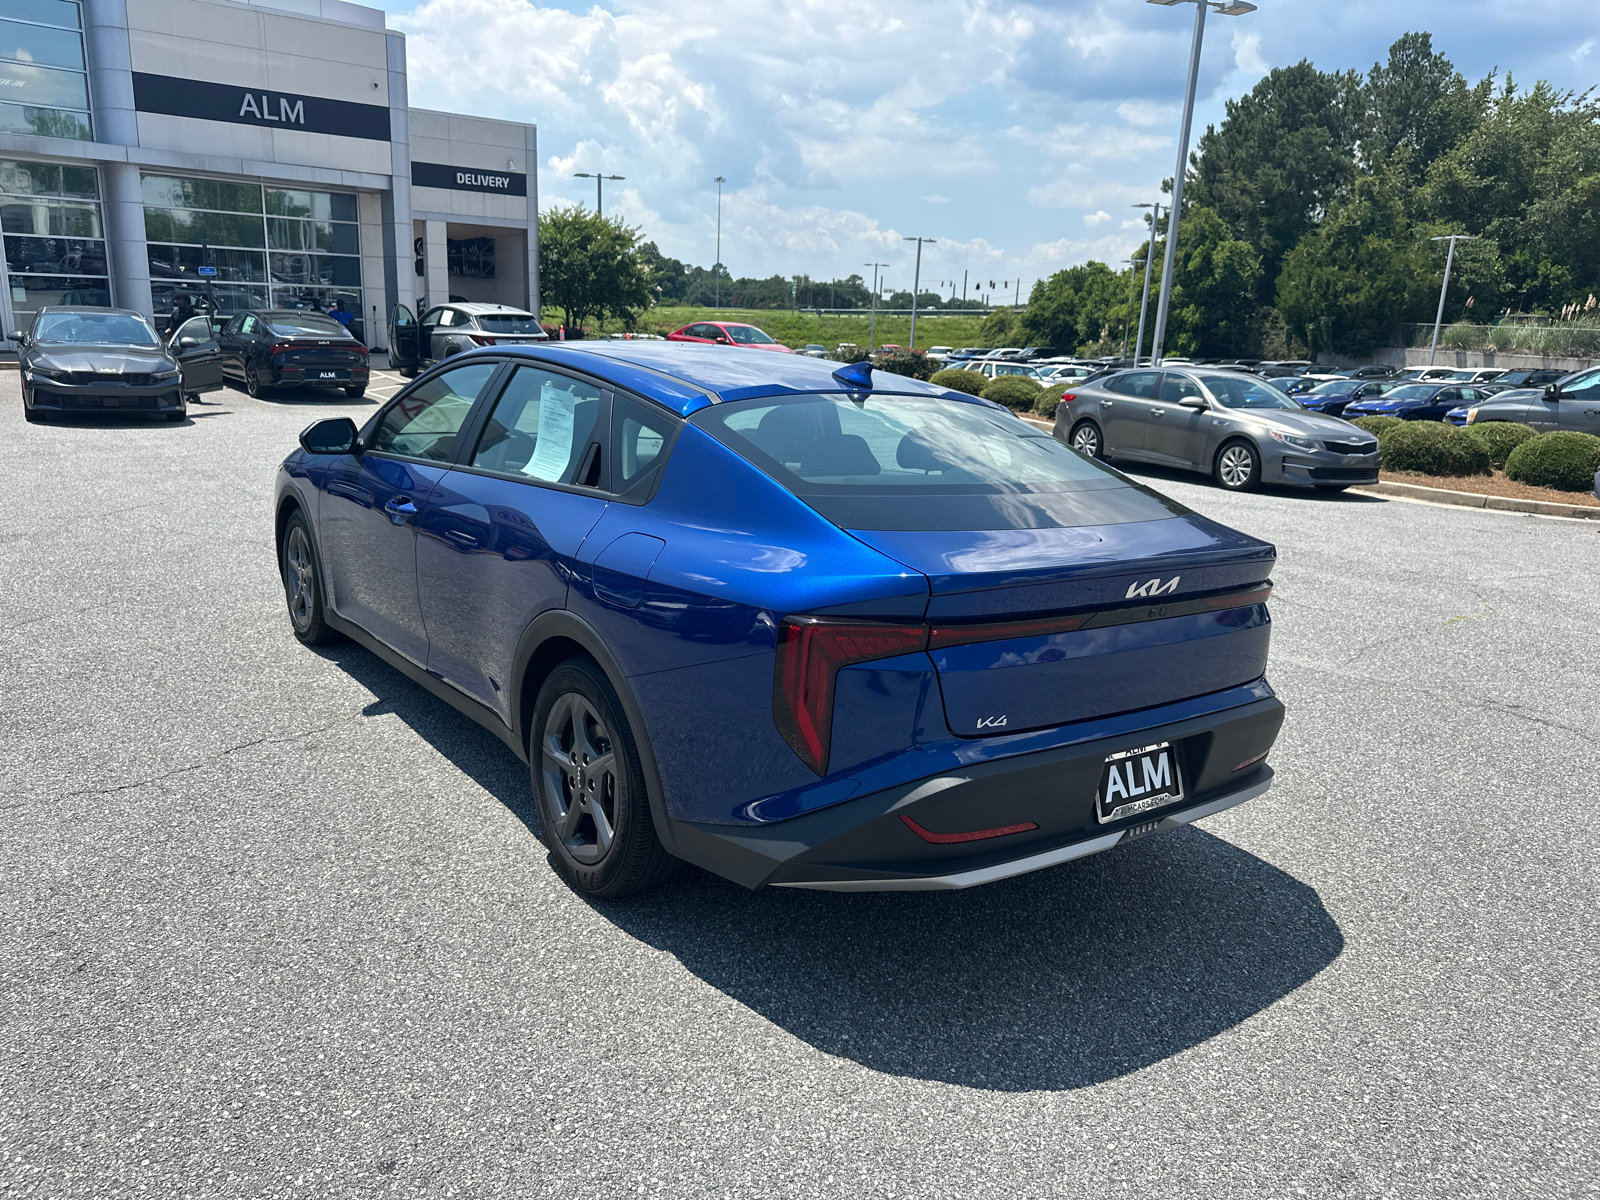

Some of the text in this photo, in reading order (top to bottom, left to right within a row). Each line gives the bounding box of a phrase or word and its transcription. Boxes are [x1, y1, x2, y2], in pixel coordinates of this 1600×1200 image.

[239, 93, 305, 124] ALM
[456, 172, 510, 189] DELIVERY
[319, 371, 336, 379] ALM
[1124, 575, 1181, 599] KIA
[976, 714, 1008, 729] K4
[1124, 746, 1147, 757] ALM
[1105, 751, 1172, 804] ALM
[1119, 796, 1166, 815] ALMCARS.COM
